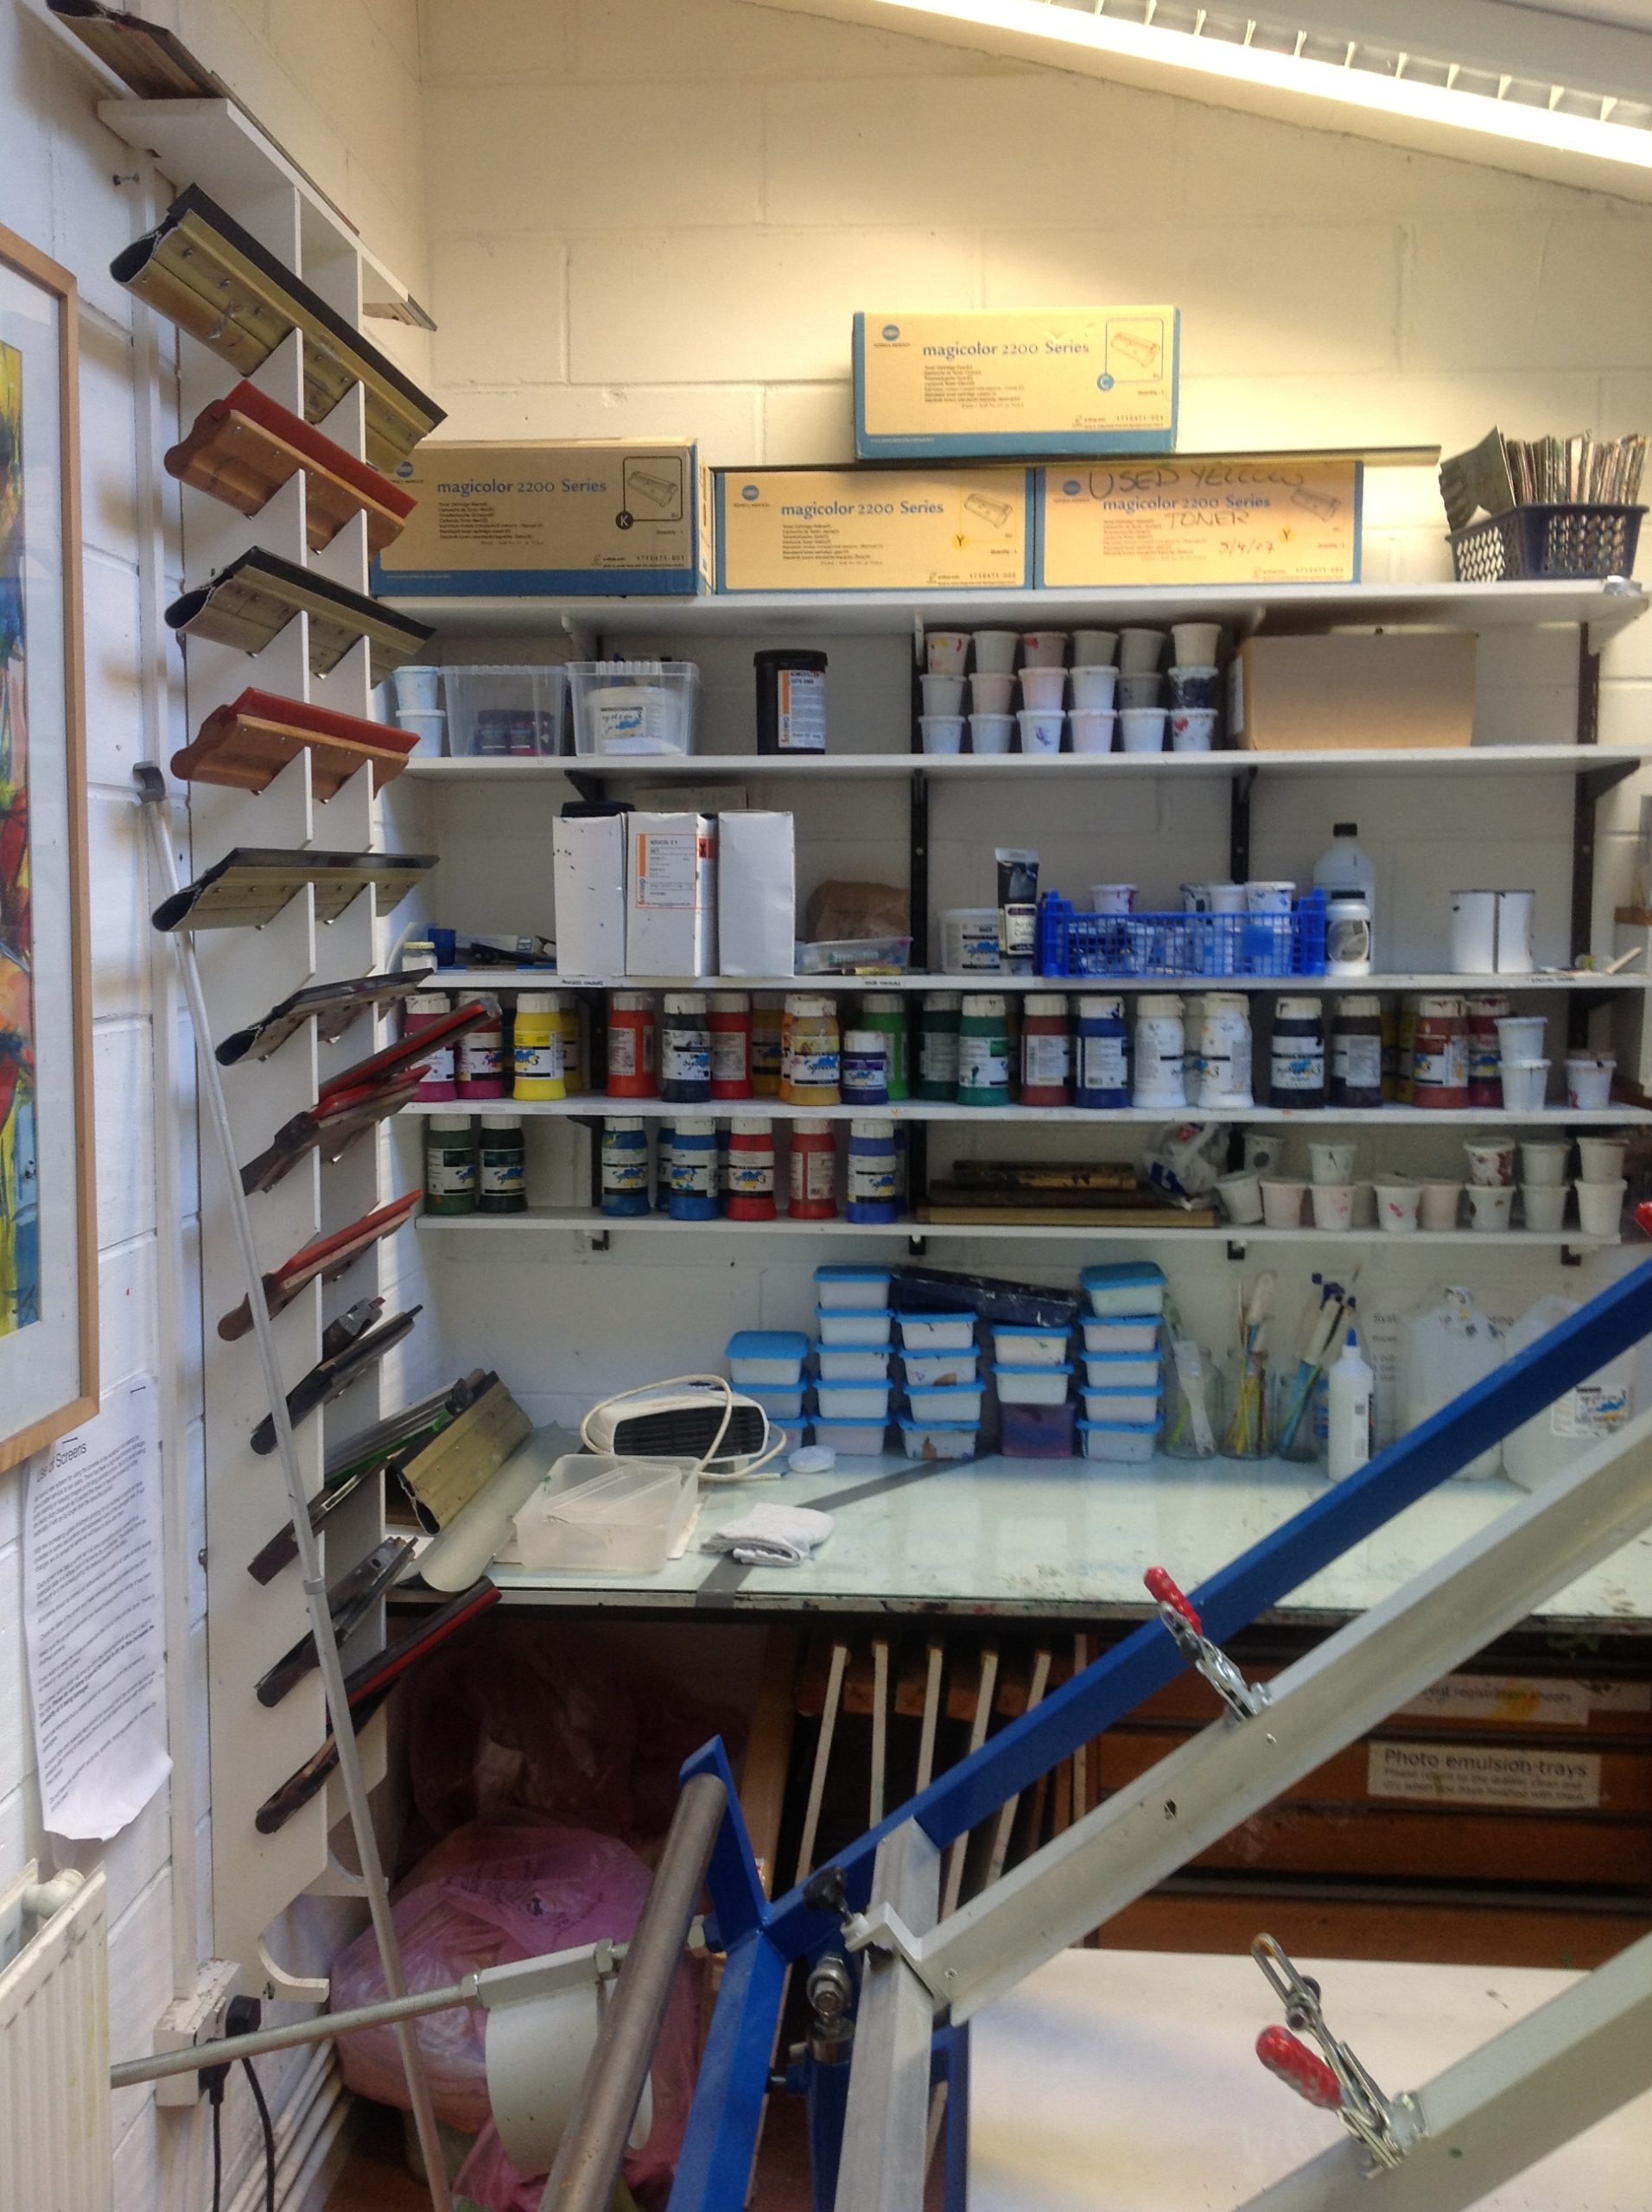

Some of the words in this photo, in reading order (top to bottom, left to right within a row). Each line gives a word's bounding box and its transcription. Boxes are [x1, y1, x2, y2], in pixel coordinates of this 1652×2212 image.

[923, 341, 996, 359] magicolor
[1001, 343, 1038, 356] 2200
[1045, 340, 1090, 354] Series
[437, 479, 513, 497] magicolor
[518, 481, 556, 493] 2200
[561, 478, 607, 493] Series
[1089, 469, 1179, 499] USED
[781, 500, 855, 519] magicolor
[858, 503, 894, 515] 2200
[899, 499, 944, 514] Series
[1103, 495, 1179, 514] magicolor
[1225, 495, 1271, 509] Series
[620, 515, 629, 526] K
[1165, 511, 1250, 530] TONER
[956, 534, 965, 547] Y
[55, 1442, 86, 1468] Screens
[1384, 1747, 1439, 1768] Photo
[1446, 1755, 1533, 1774] emulsion
[1539, 1760, 1587, 1778] trays
